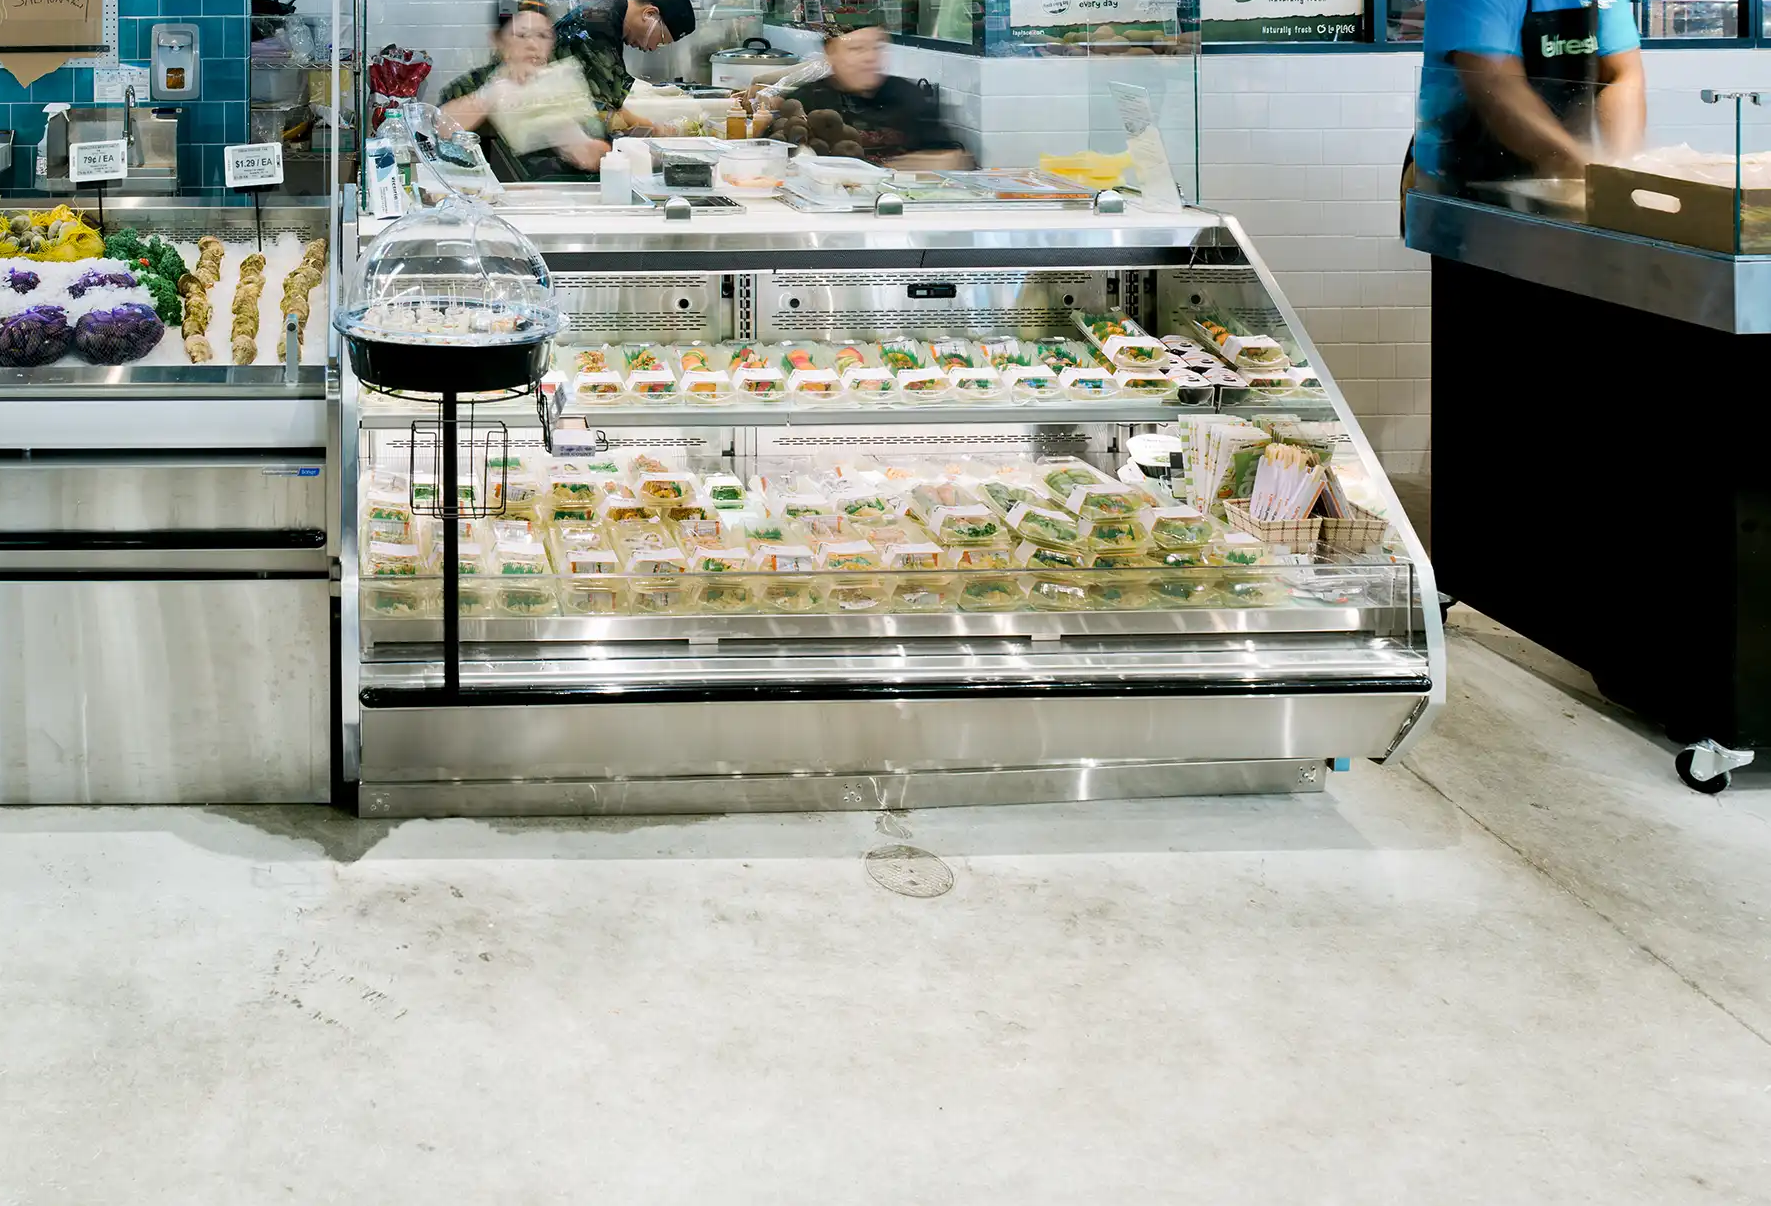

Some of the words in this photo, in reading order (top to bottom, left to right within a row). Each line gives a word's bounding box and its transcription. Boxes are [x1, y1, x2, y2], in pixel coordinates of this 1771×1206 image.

[1079, 0, 1101, 10] every
[1102, 0, 1118, 9] day
[1262, 25, 1291, 35] Naturally
[1295, 25, 1312, 33] fresh
[1328, 25, 1335, 34] La
[1336, 24, 1356, 34] PLACE
[83, 156, 97, 164] 79¢
[103, 154, 114, 163] EA
[235, 159, 255, 168] $1.29
[261, 157, 273, 166] EA
